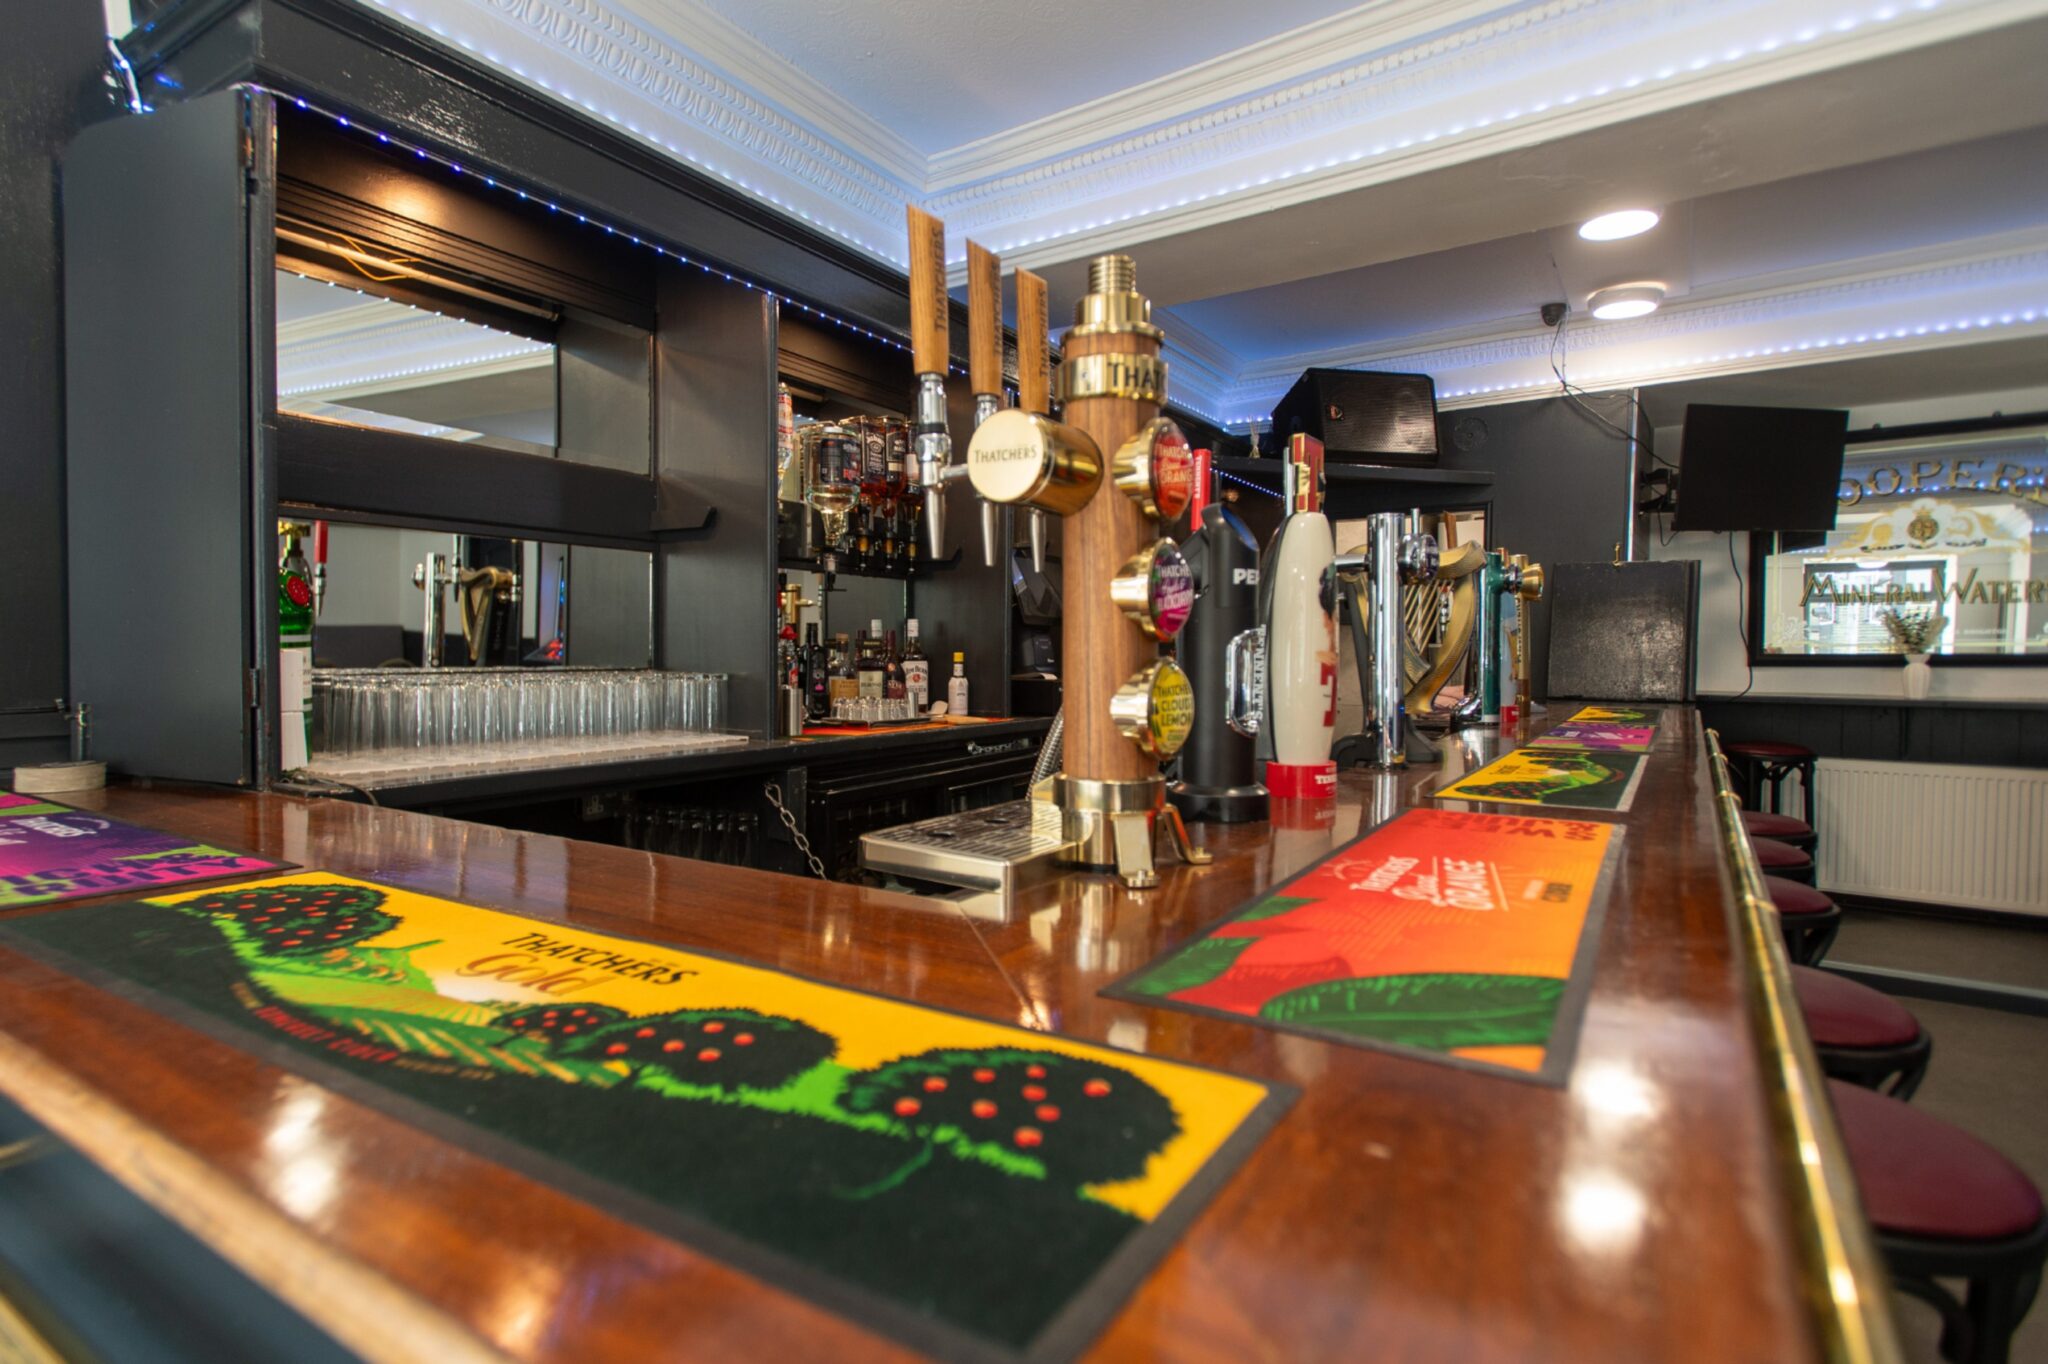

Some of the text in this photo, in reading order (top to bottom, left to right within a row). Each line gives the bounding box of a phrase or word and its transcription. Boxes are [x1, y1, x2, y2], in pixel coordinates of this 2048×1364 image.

[931, 227, 946, 332] THATCHERS
[975, 444, 1038, 463] THATCHERS
[1838, 458, 2028, 506] OOPER
[1800, 573, 1925, 606] MINERAL
[2, 858, 154, 886] ICH
[12, 857, 244, 897] RUITY
[455, 952, 618, 997] Gold
[501, 931, 700, 986] THATCHERS
